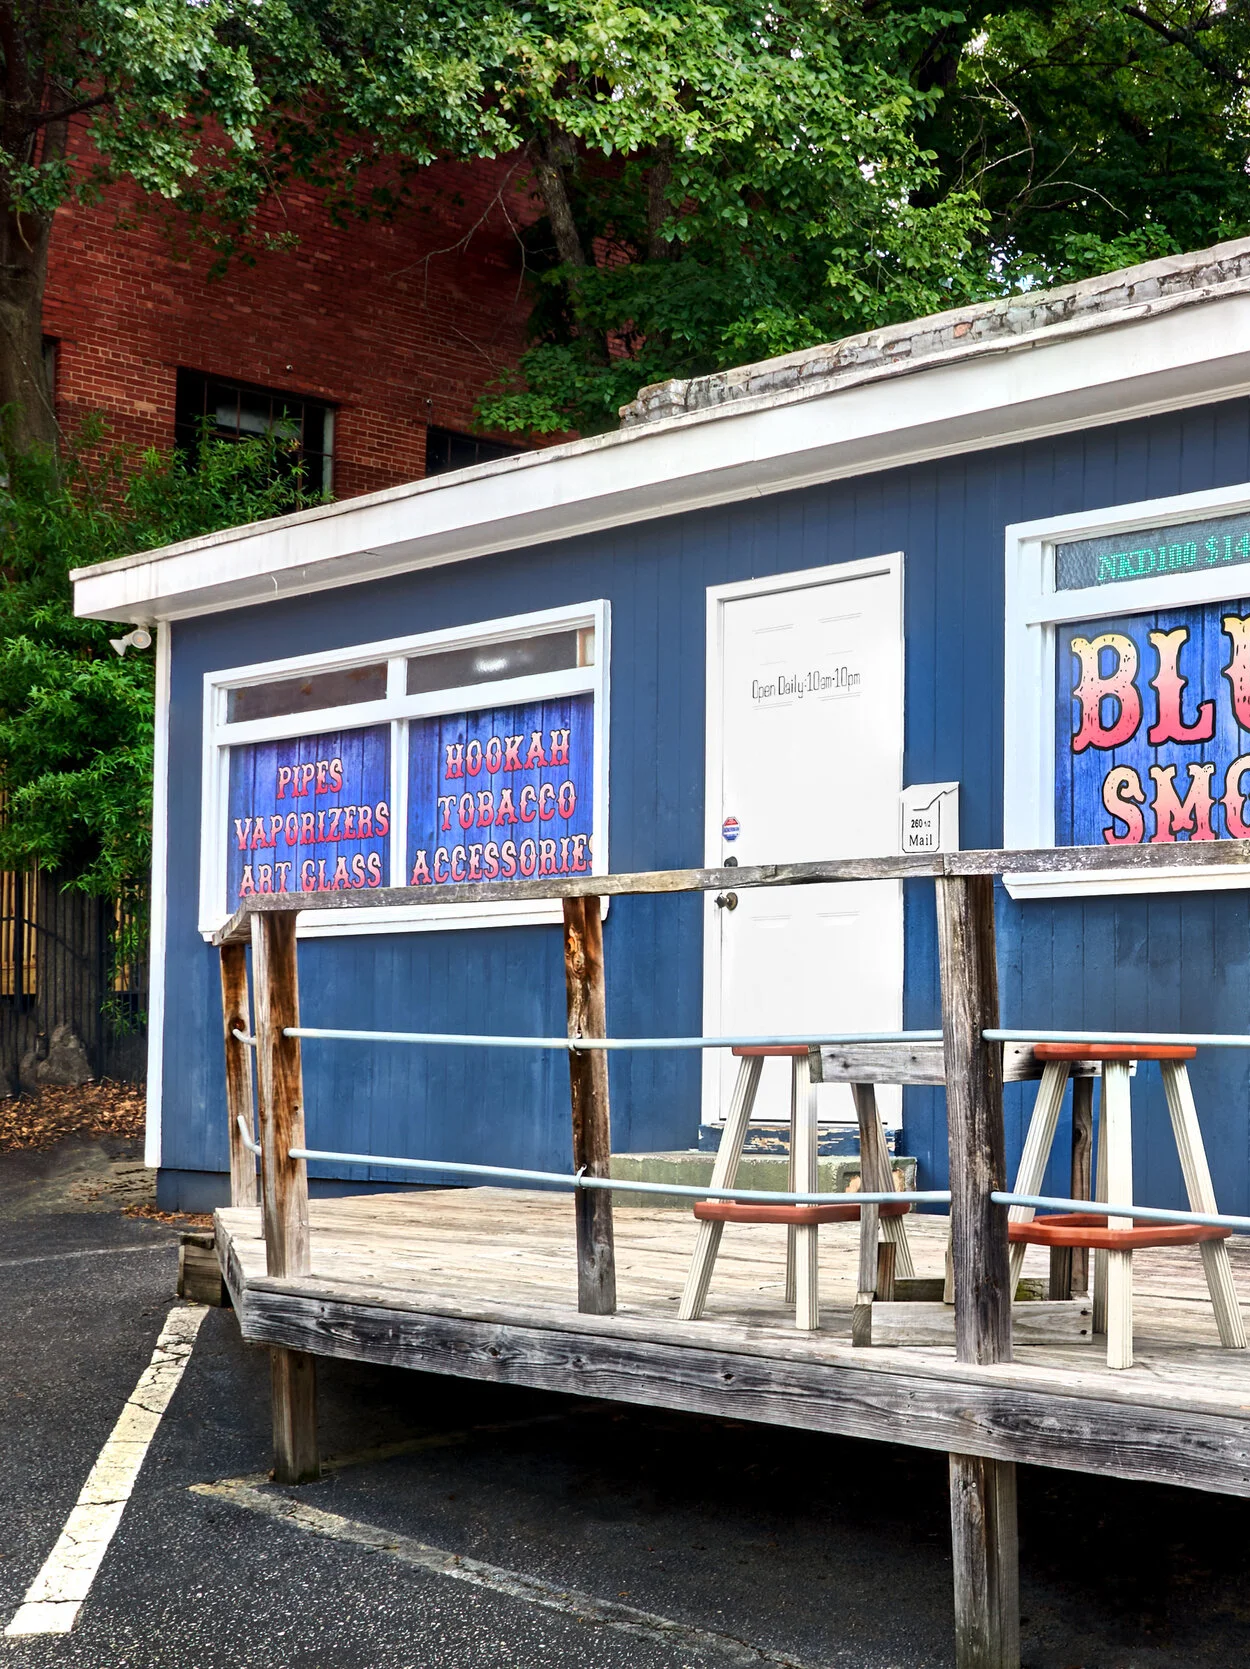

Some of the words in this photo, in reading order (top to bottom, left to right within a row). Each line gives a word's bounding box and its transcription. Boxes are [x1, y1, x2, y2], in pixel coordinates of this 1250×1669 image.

[1096, 541, 1198, 582] NKD100
[752, 679, 776, 703] Open
[445, 728, 572, 781] HOOKAH
[276, 758, 344, 800] PIPES
[234, 800, 391, 852] VAPORIZERS
[437, 780, 578, 832] TOBACCO
[910, 818, 923, 829] 260
[909, 833, 933, 847] Mail
[238, 860, 292, 899] ART
[299, 852, 383, 892] GLASS
